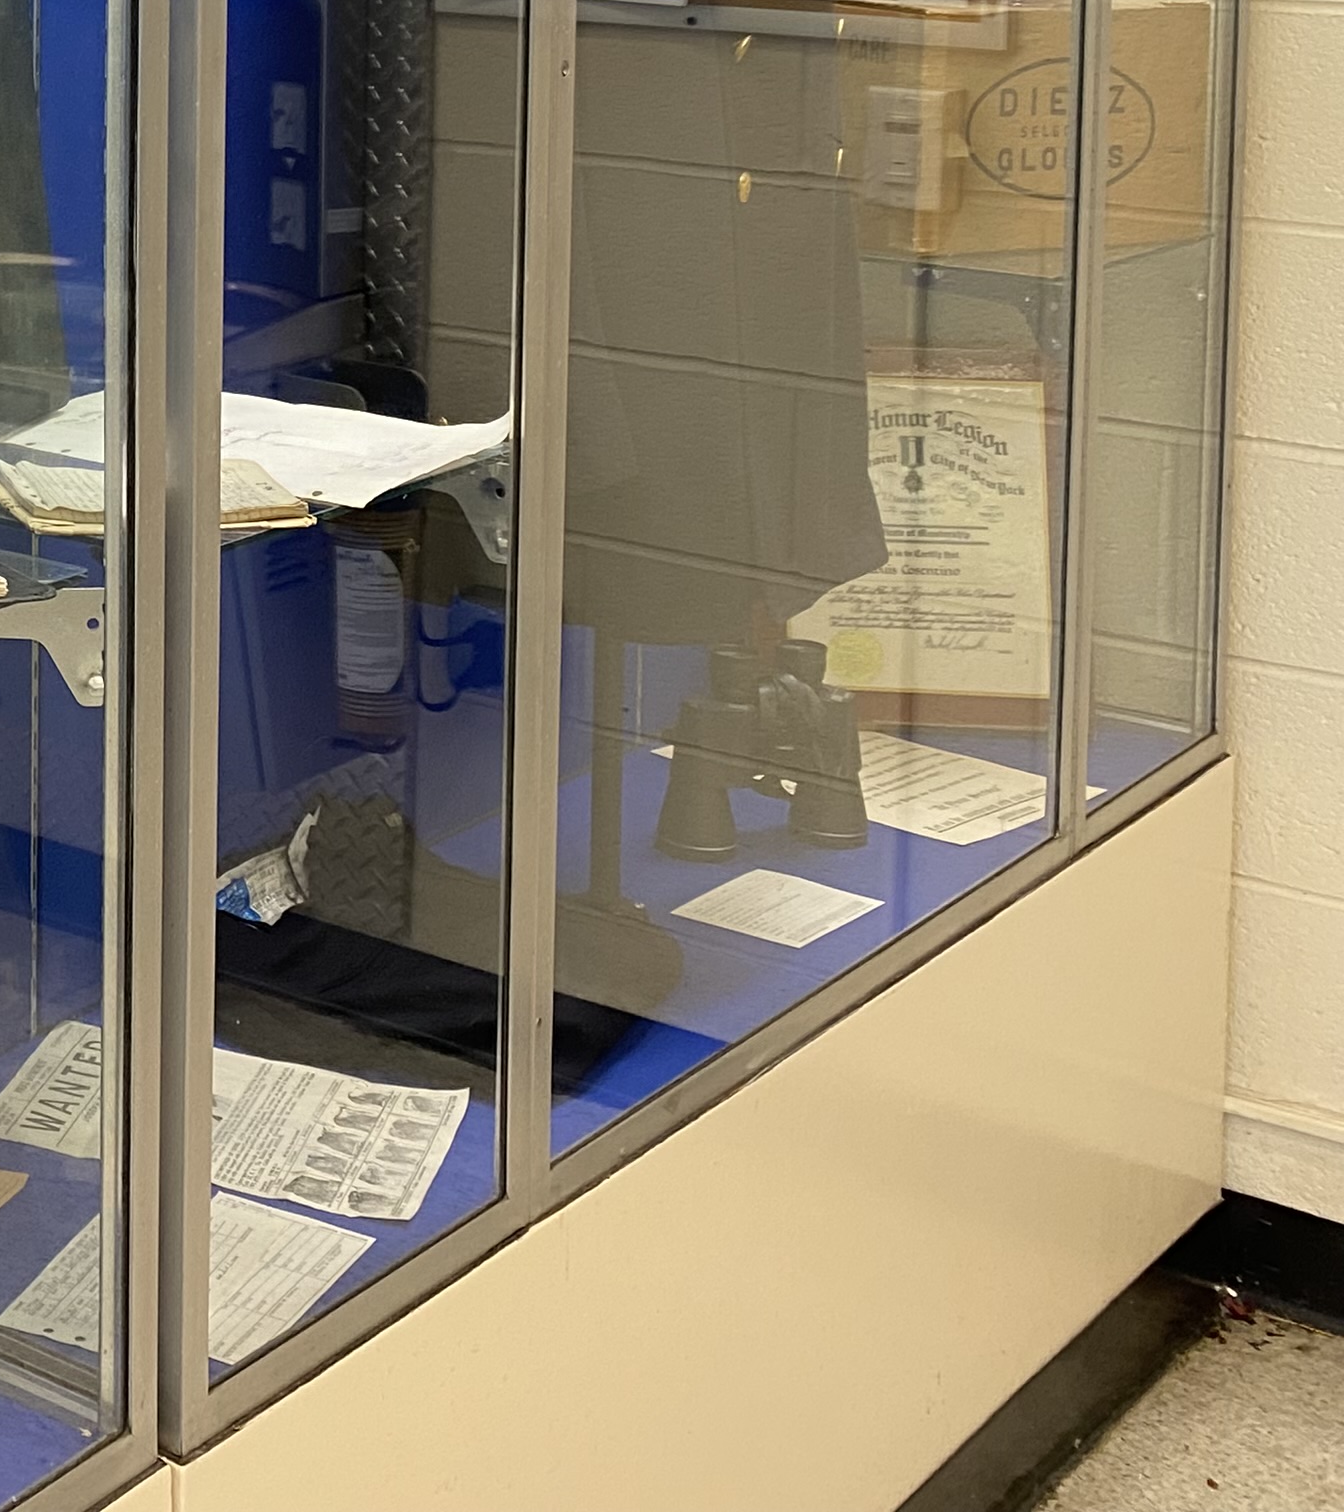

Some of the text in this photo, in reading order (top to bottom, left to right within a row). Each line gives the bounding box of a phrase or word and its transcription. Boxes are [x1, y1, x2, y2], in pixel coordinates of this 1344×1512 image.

[999, 85, 1126, 117] DIEZ
[997, 145, 1124, 173] GLOS
[934, 410, 1009, 456] Legion
